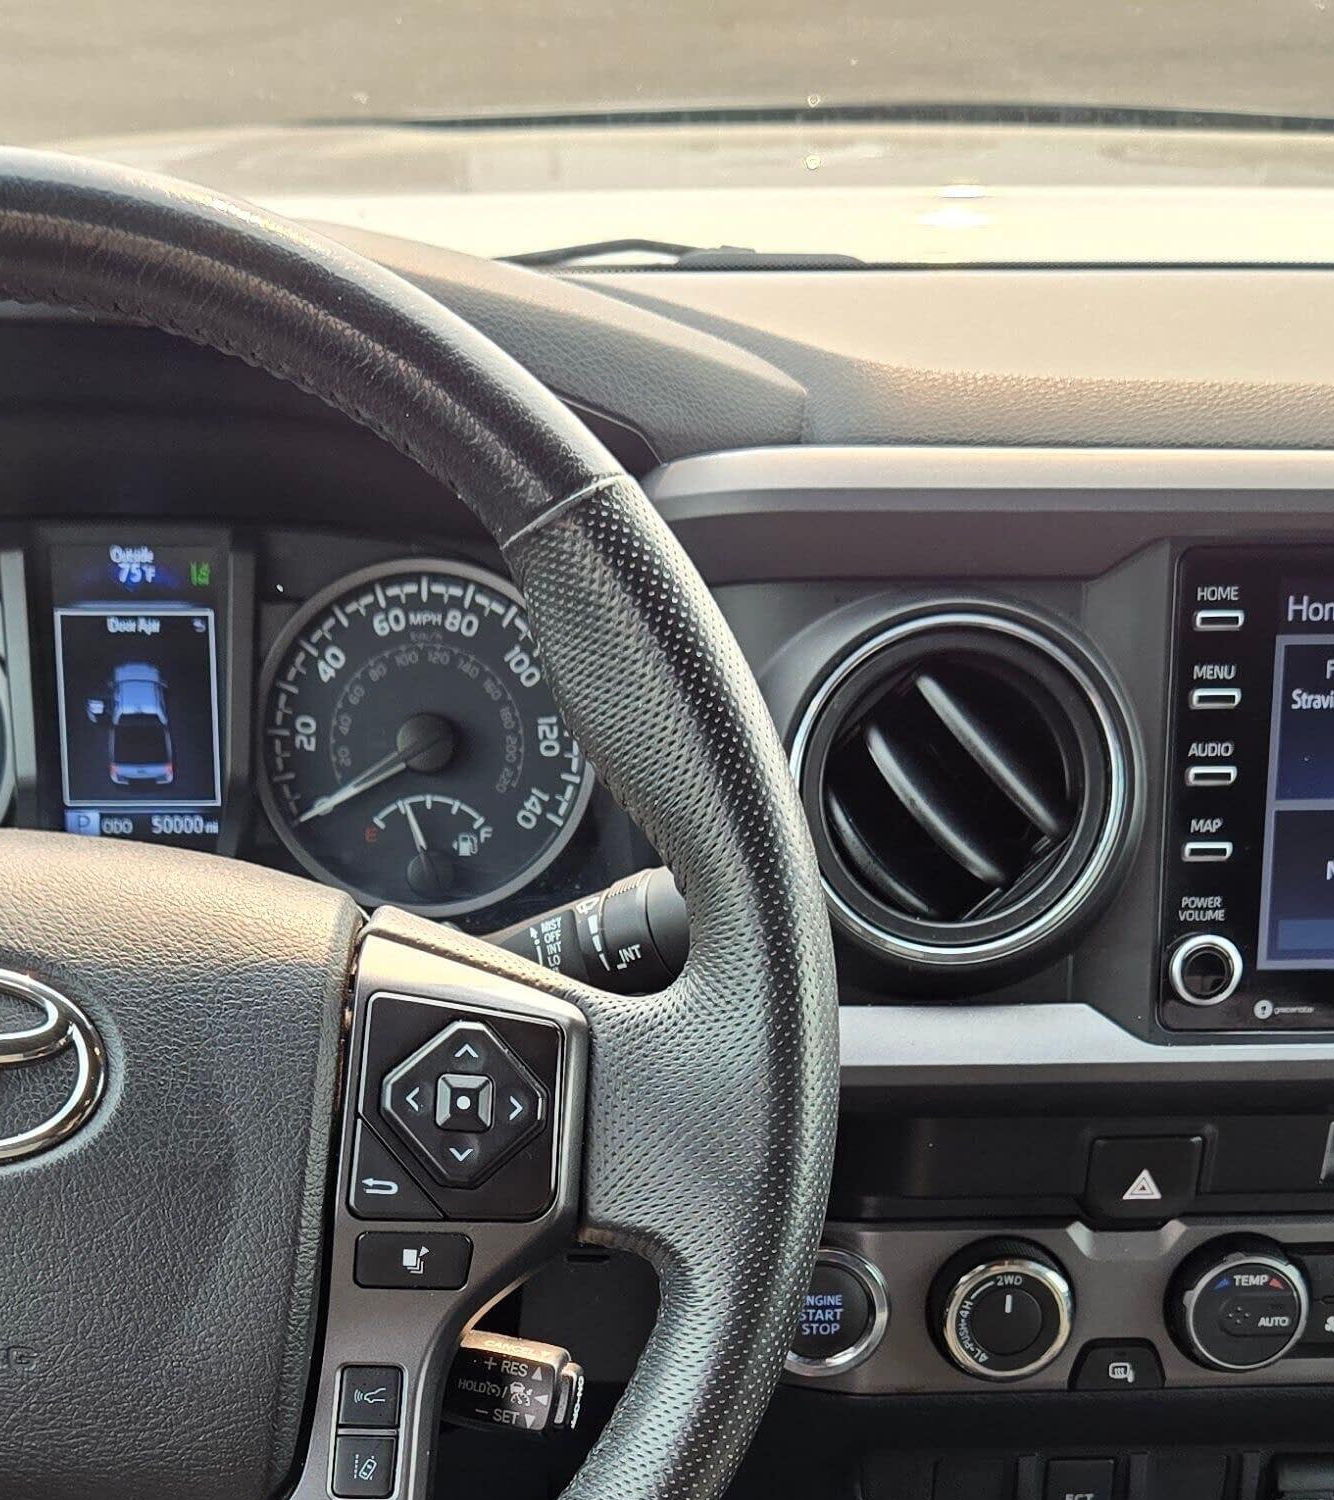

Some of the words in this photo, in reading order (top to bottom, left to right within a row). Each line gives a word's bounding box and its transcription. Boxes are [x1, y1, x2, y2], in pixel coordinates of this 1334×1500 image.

[1196, 586, 1240, 602] HOME
[373, 607, 406, 637] 60
[409, 612, 442, 626] MPH
[444, 609, 479, 637] 80
[317, 645, 346, 683] 40
[427, 651, 450, 665] 120
[503, 646, 541, 688] 100
[1193, 664, 1236, 680] MENU
[295, 714, 317, 752] 20
[536, 716, 561, 757] 120
[1187, 742, 1234, 757] AUDIO
[516, 787, 550, 830] 140
[78, 815, 90, 828] P
[151, 815, 204, 834] 50000
[1190, 818, 1223, 833] MAP
[479, 828, 493, 843] F
[1181, 896, 1222, 909] POWER
[1178, 908, 1225, 922] VOLUME
[541, 917, 561, 932] MIST
[544, 930, 561, 944] OFF
[546, 942, 562, 955] INT
[620, 944, 643, 964] INT
[547, 954, 561, 967] LO
[996, 1275, 1023, 1286] 2WD
[1233, 1274, 1269, 1287] TEMP
[805, 1294, 843, 1306] NGINE
[801, 1322, 841, 1336] STOP
[1258, 1316, 1291, 1328] AUTO
[484, 1340, 536, 1357] CANCEL
[500, 1360, 529, 1378] RES
[457, 1378, 486, 1395] HOLD
[492, 1408, 520, 1425] SET
